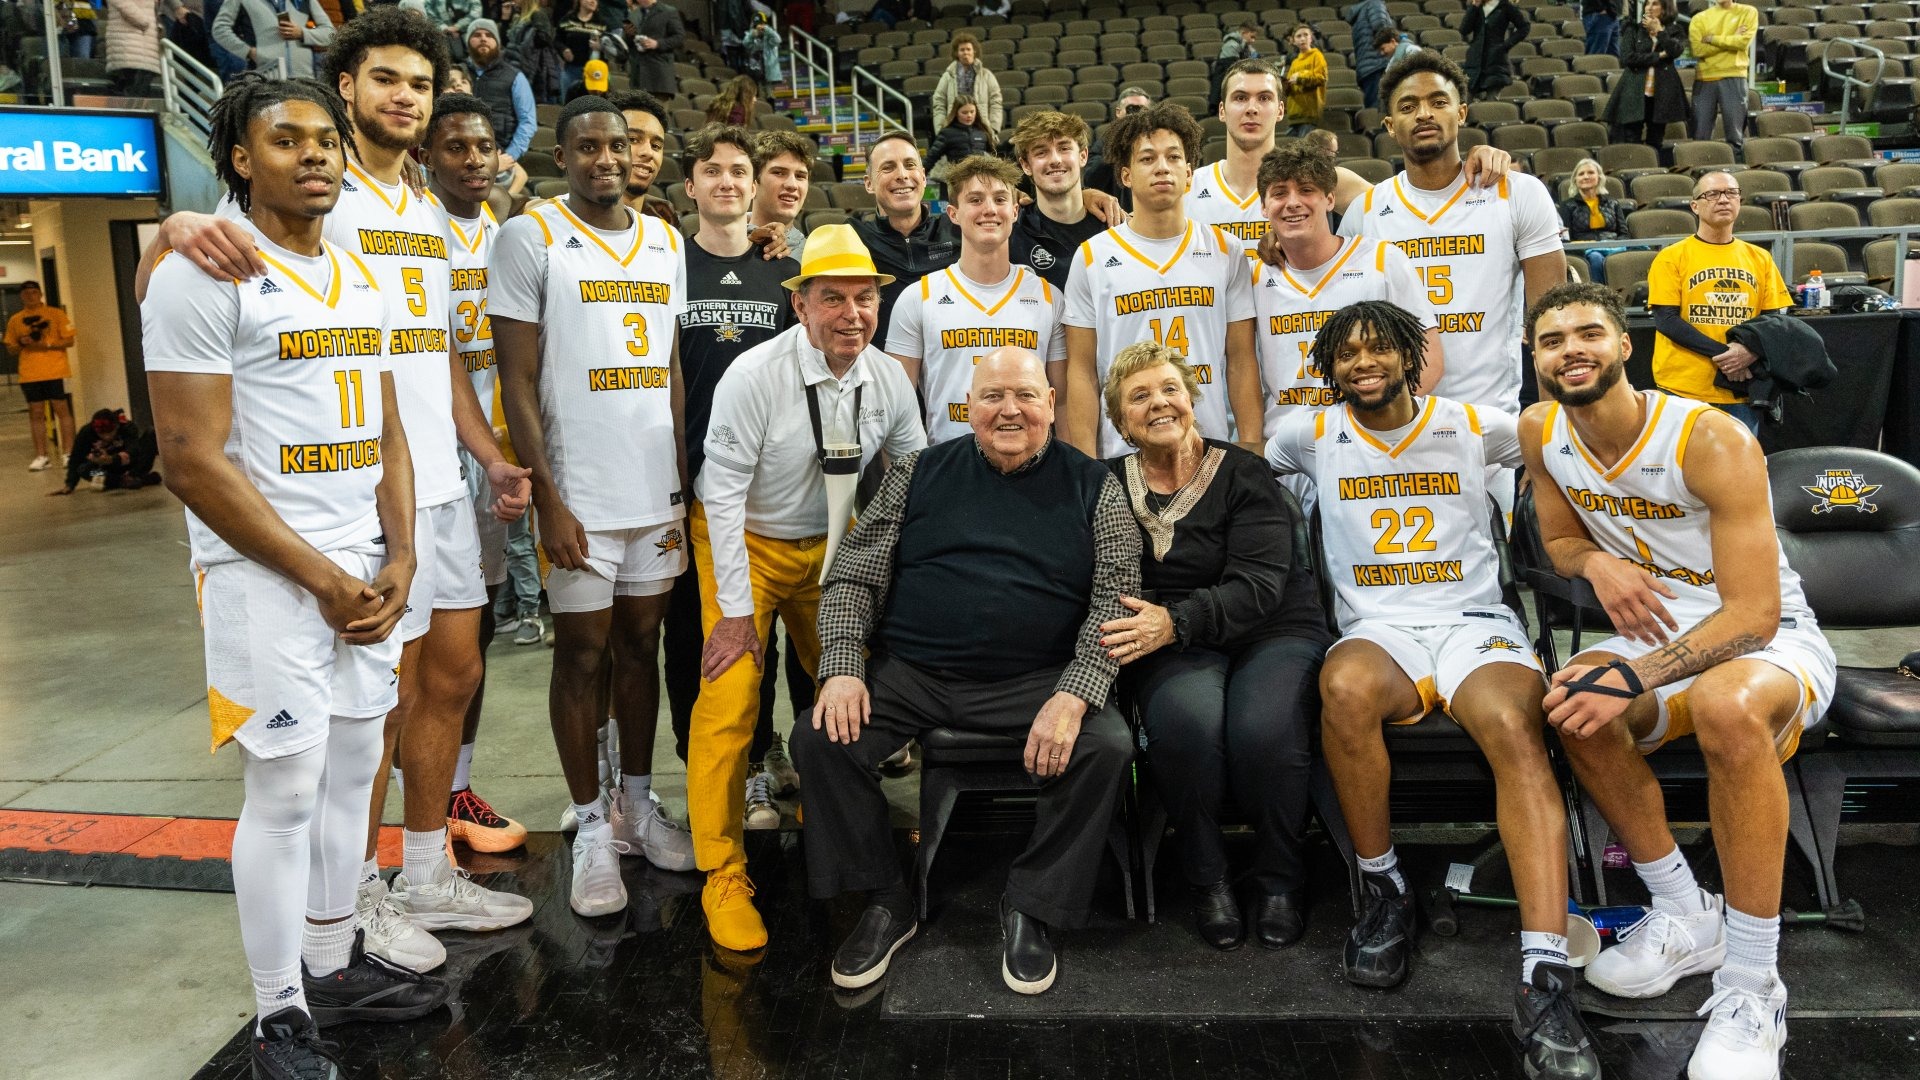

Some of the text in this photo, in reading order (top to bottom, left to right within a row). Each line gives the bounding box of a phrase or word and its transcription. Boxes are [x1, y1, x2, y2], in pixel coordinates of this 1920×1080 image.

[53, 141, 148, 172] Bank
[358, 228, 448, 261] NORTHERN
[1392, 234, 1485, 259] ORTHERN
[401, 267, 427, 317] 5
[579, 280, 671, 305] NORTHERN
[1114, 285, 1215, 316] NORTHERN
[1415, 265, 1453, 305] 5
[456, 298, 493, 344] 32
[679, 310, 776, 326] BASKETBALL
[730, 302, 778, 315] KENTUCKY
[389, 328, 448, 355] ENTUCK
[623, 313, 649, 356] 3
[941, 327, 1038, 350] NORTHERN
[1150, 316, 1189, 357] 14
[334, 370, 364, 428] 11
[1339, 472, 1461, 500] NORTHERN
[1566, 485, 1686, 519] NORTHERN
[1371, 506, 1437, 555] 22
[1353, 560, 1464, 586] KENTUCKY
[266, 719, 298, 729] adidas
[276, 988, 299, 999] adidas
